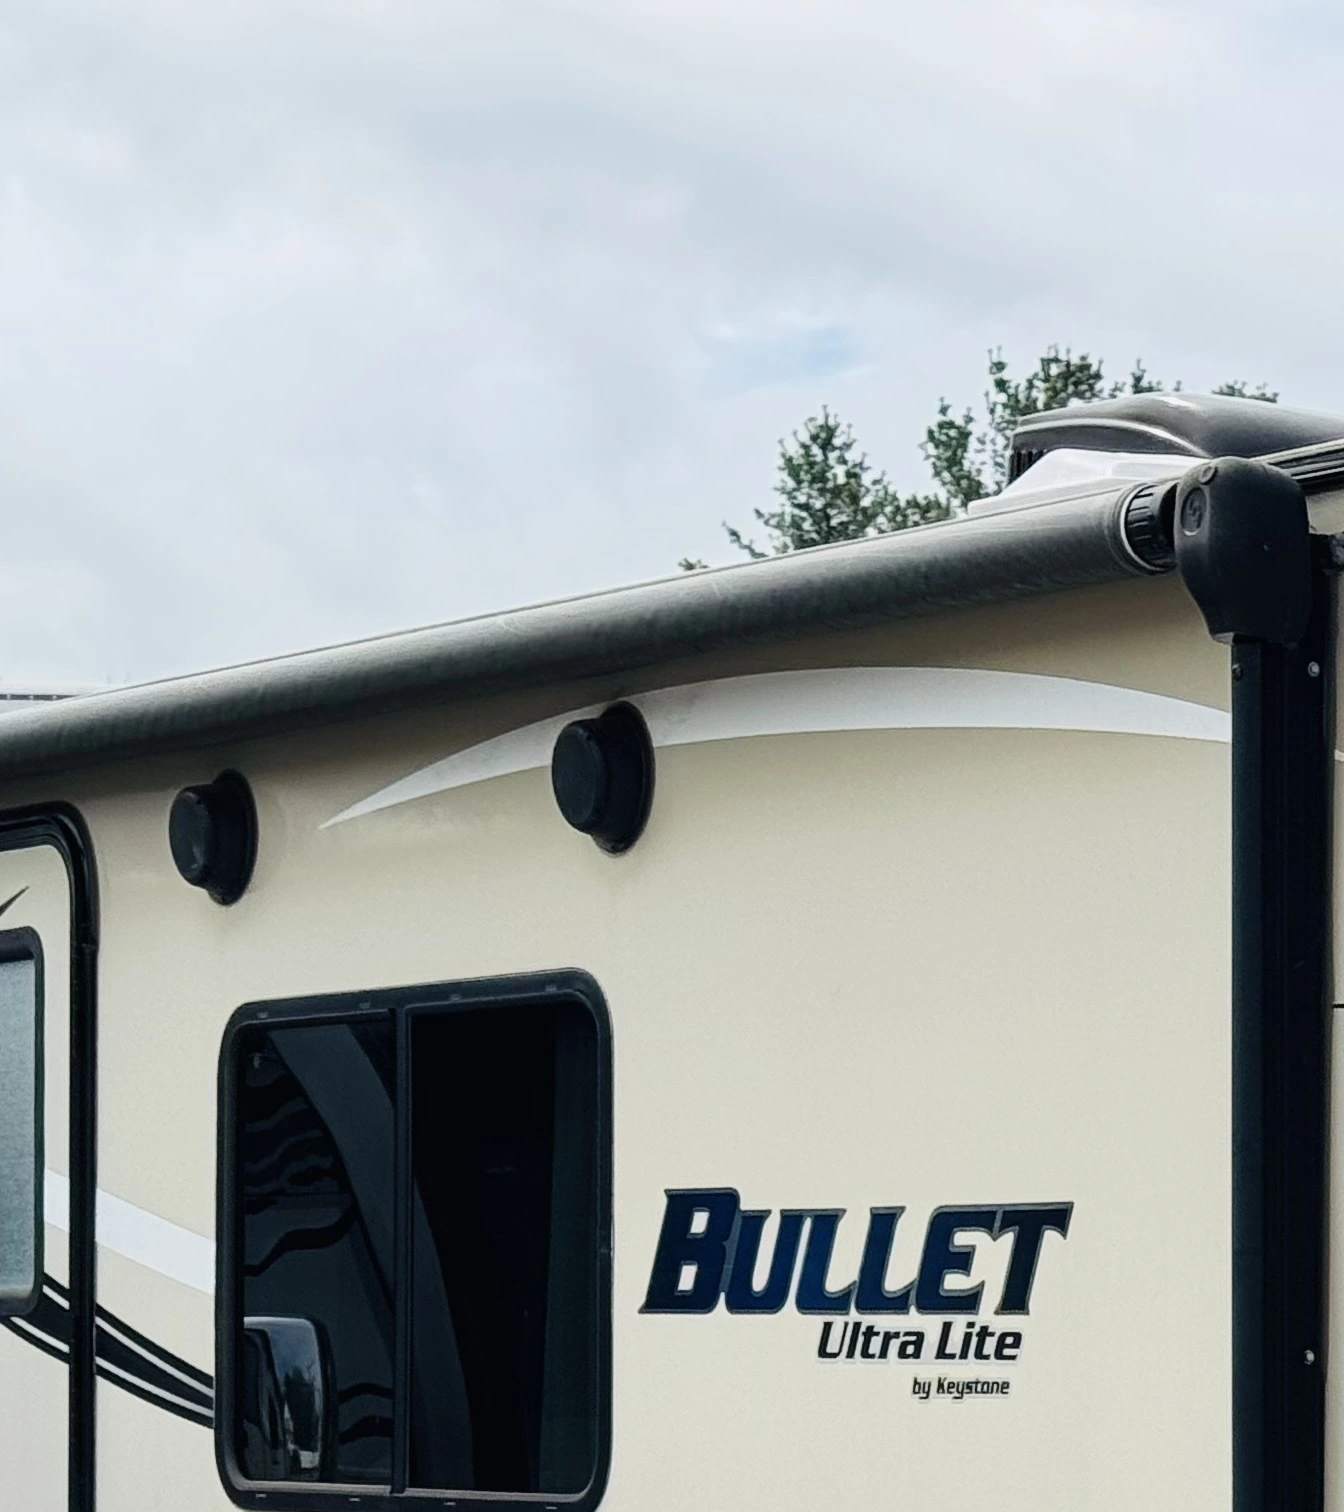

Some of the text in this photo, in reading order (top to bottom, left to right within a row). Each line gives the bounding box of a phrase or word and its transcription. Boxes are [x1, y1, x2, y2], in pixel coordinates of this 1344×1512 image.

[638, 1187, 1074, 1315] BULLET
[817, 1321, 1023, 1361] Ultra Lite
[912, 1376, 1010, 1400] by Keystone
